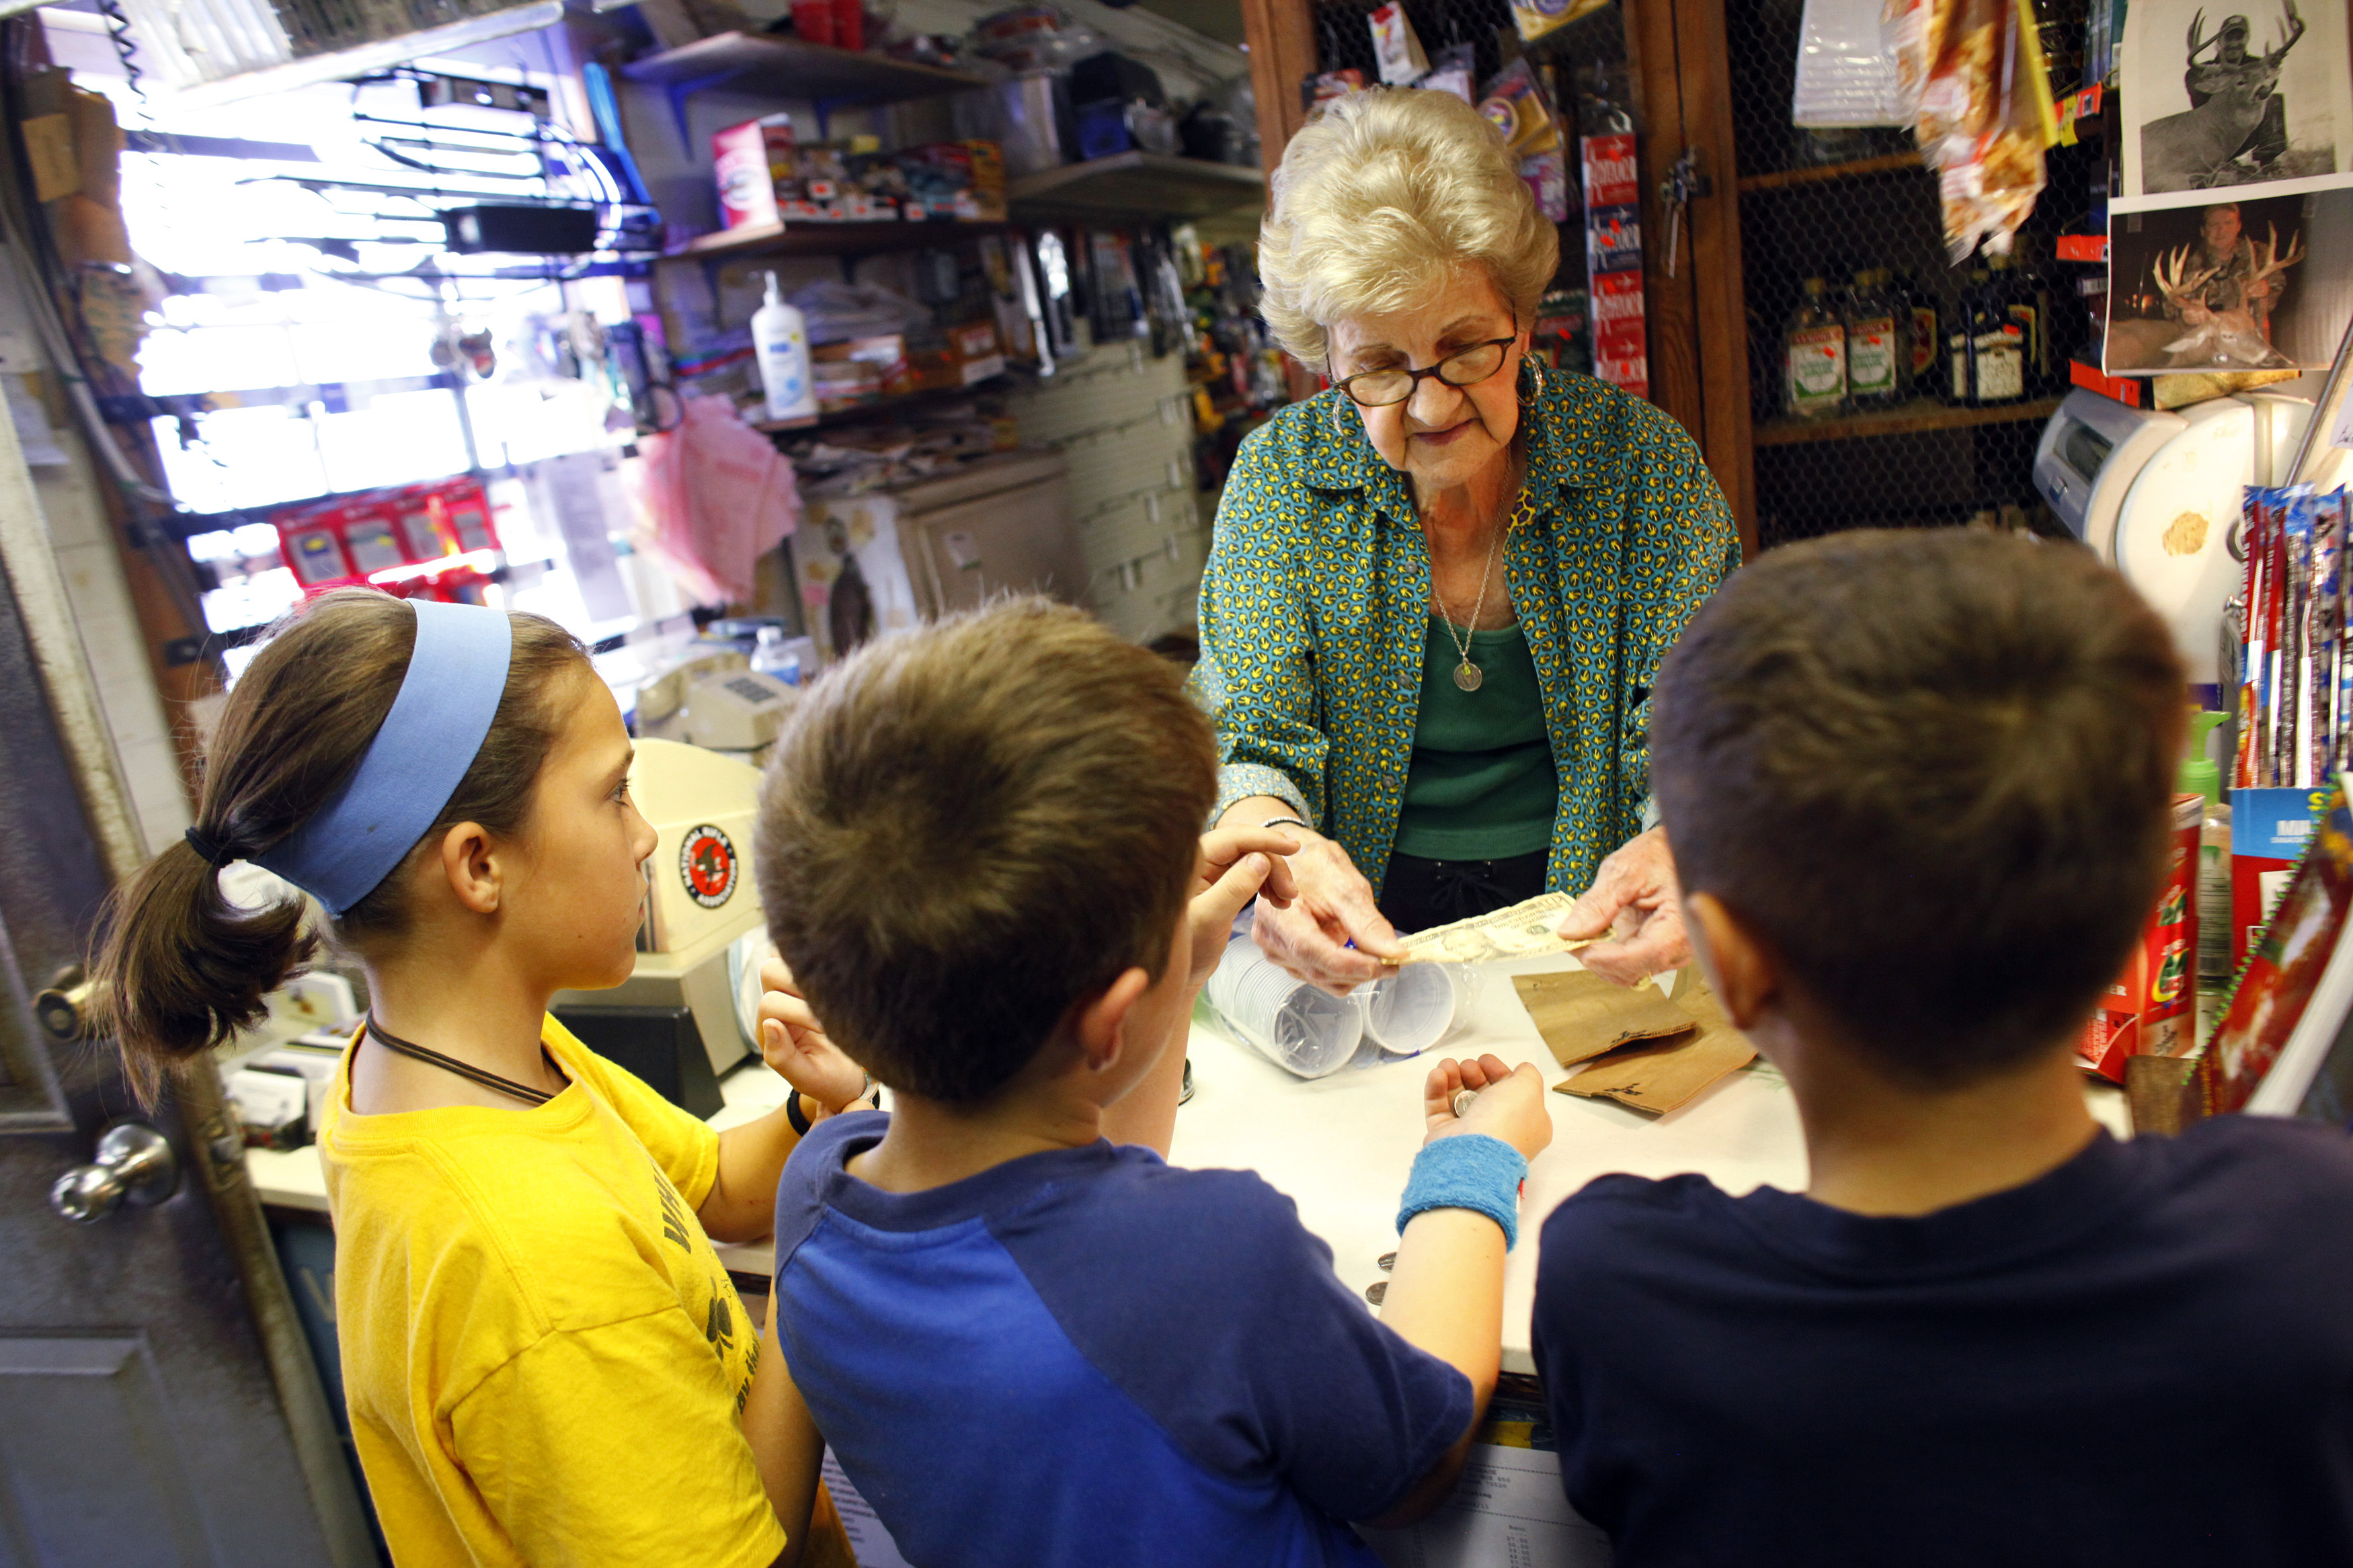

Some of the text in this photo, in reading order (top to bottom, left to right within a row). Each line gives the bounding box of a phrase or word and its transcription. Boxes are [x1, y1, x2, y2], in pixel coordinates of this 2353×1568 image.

[681, 826, 737, 907] NATIONAL RIFLE ASSOCIATION
